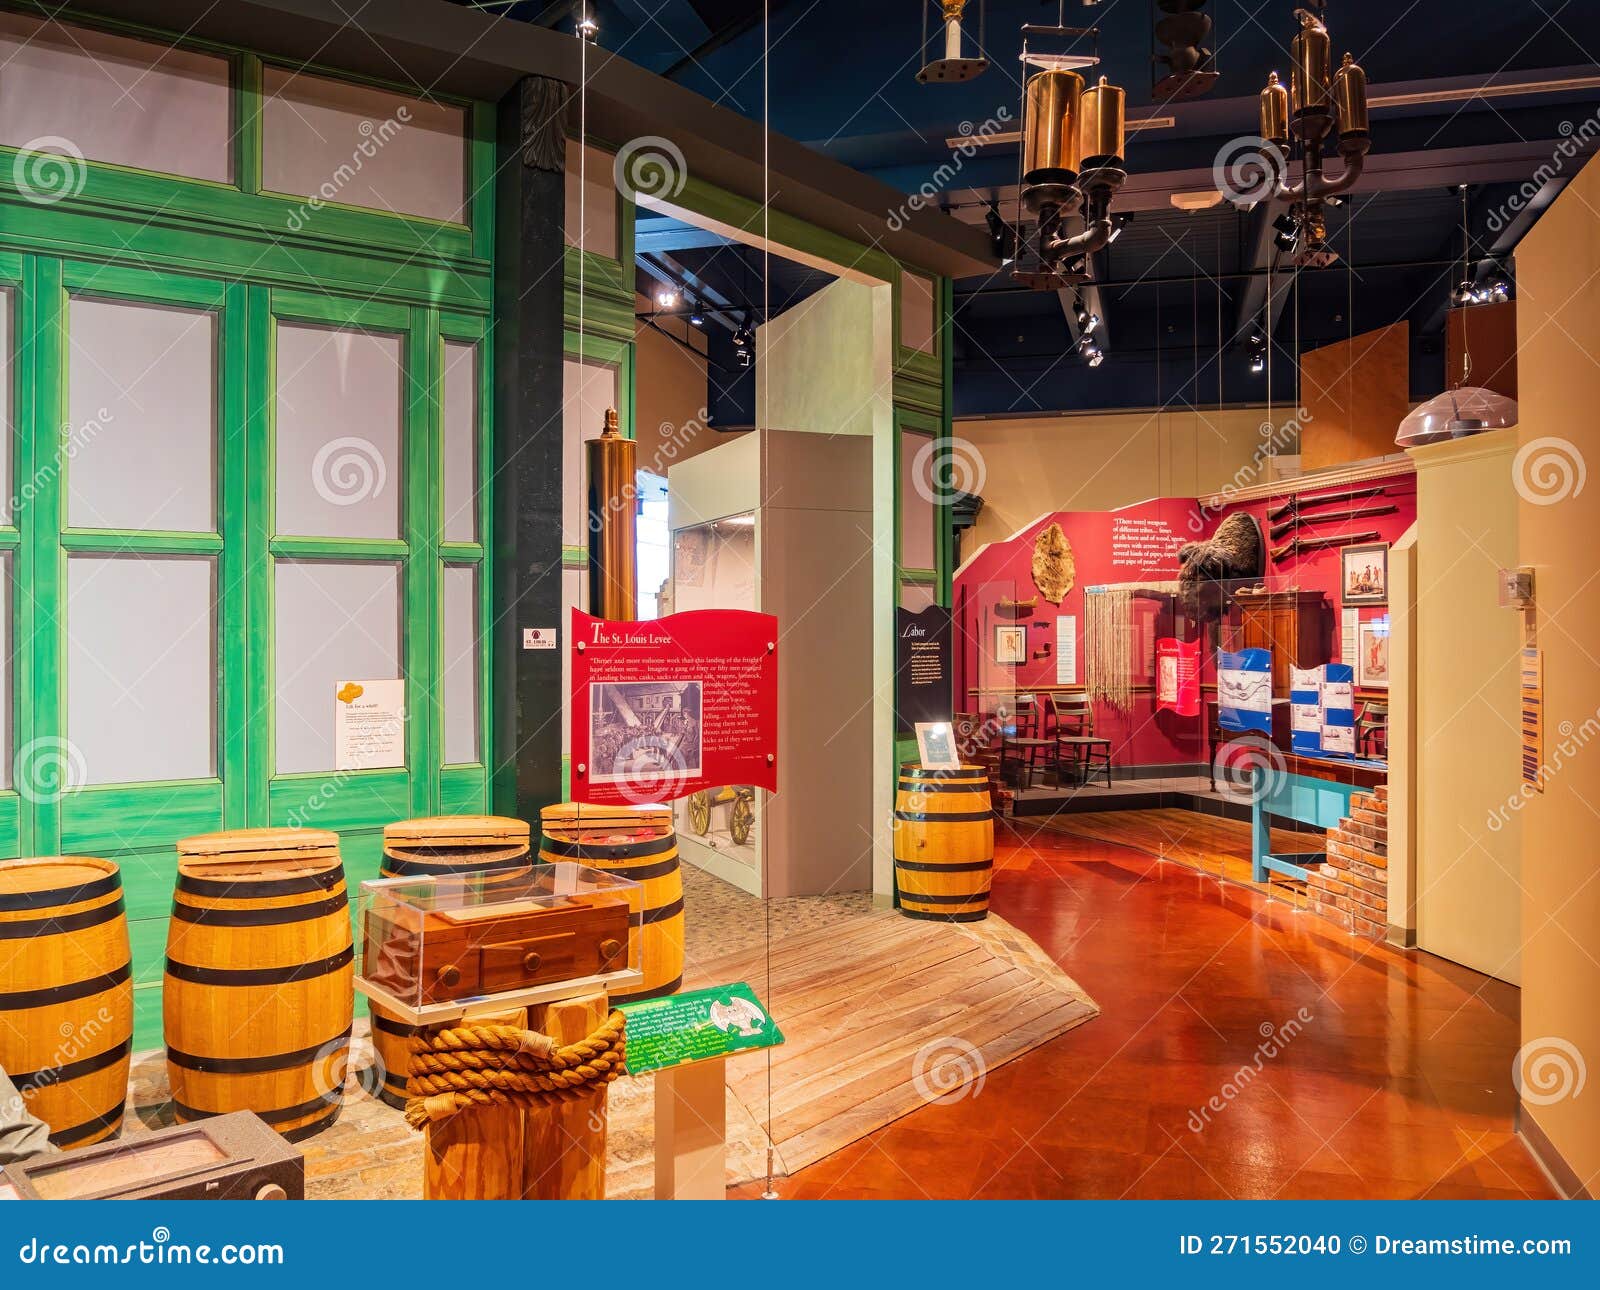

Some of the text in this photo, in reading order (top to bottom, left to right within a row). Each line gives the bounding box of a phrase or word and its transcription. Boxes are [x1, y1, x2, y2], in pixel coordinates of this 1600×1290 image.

[590, 622, 672, 644] The St. Louis Levee
[900, 622, 926, 638] Labor
